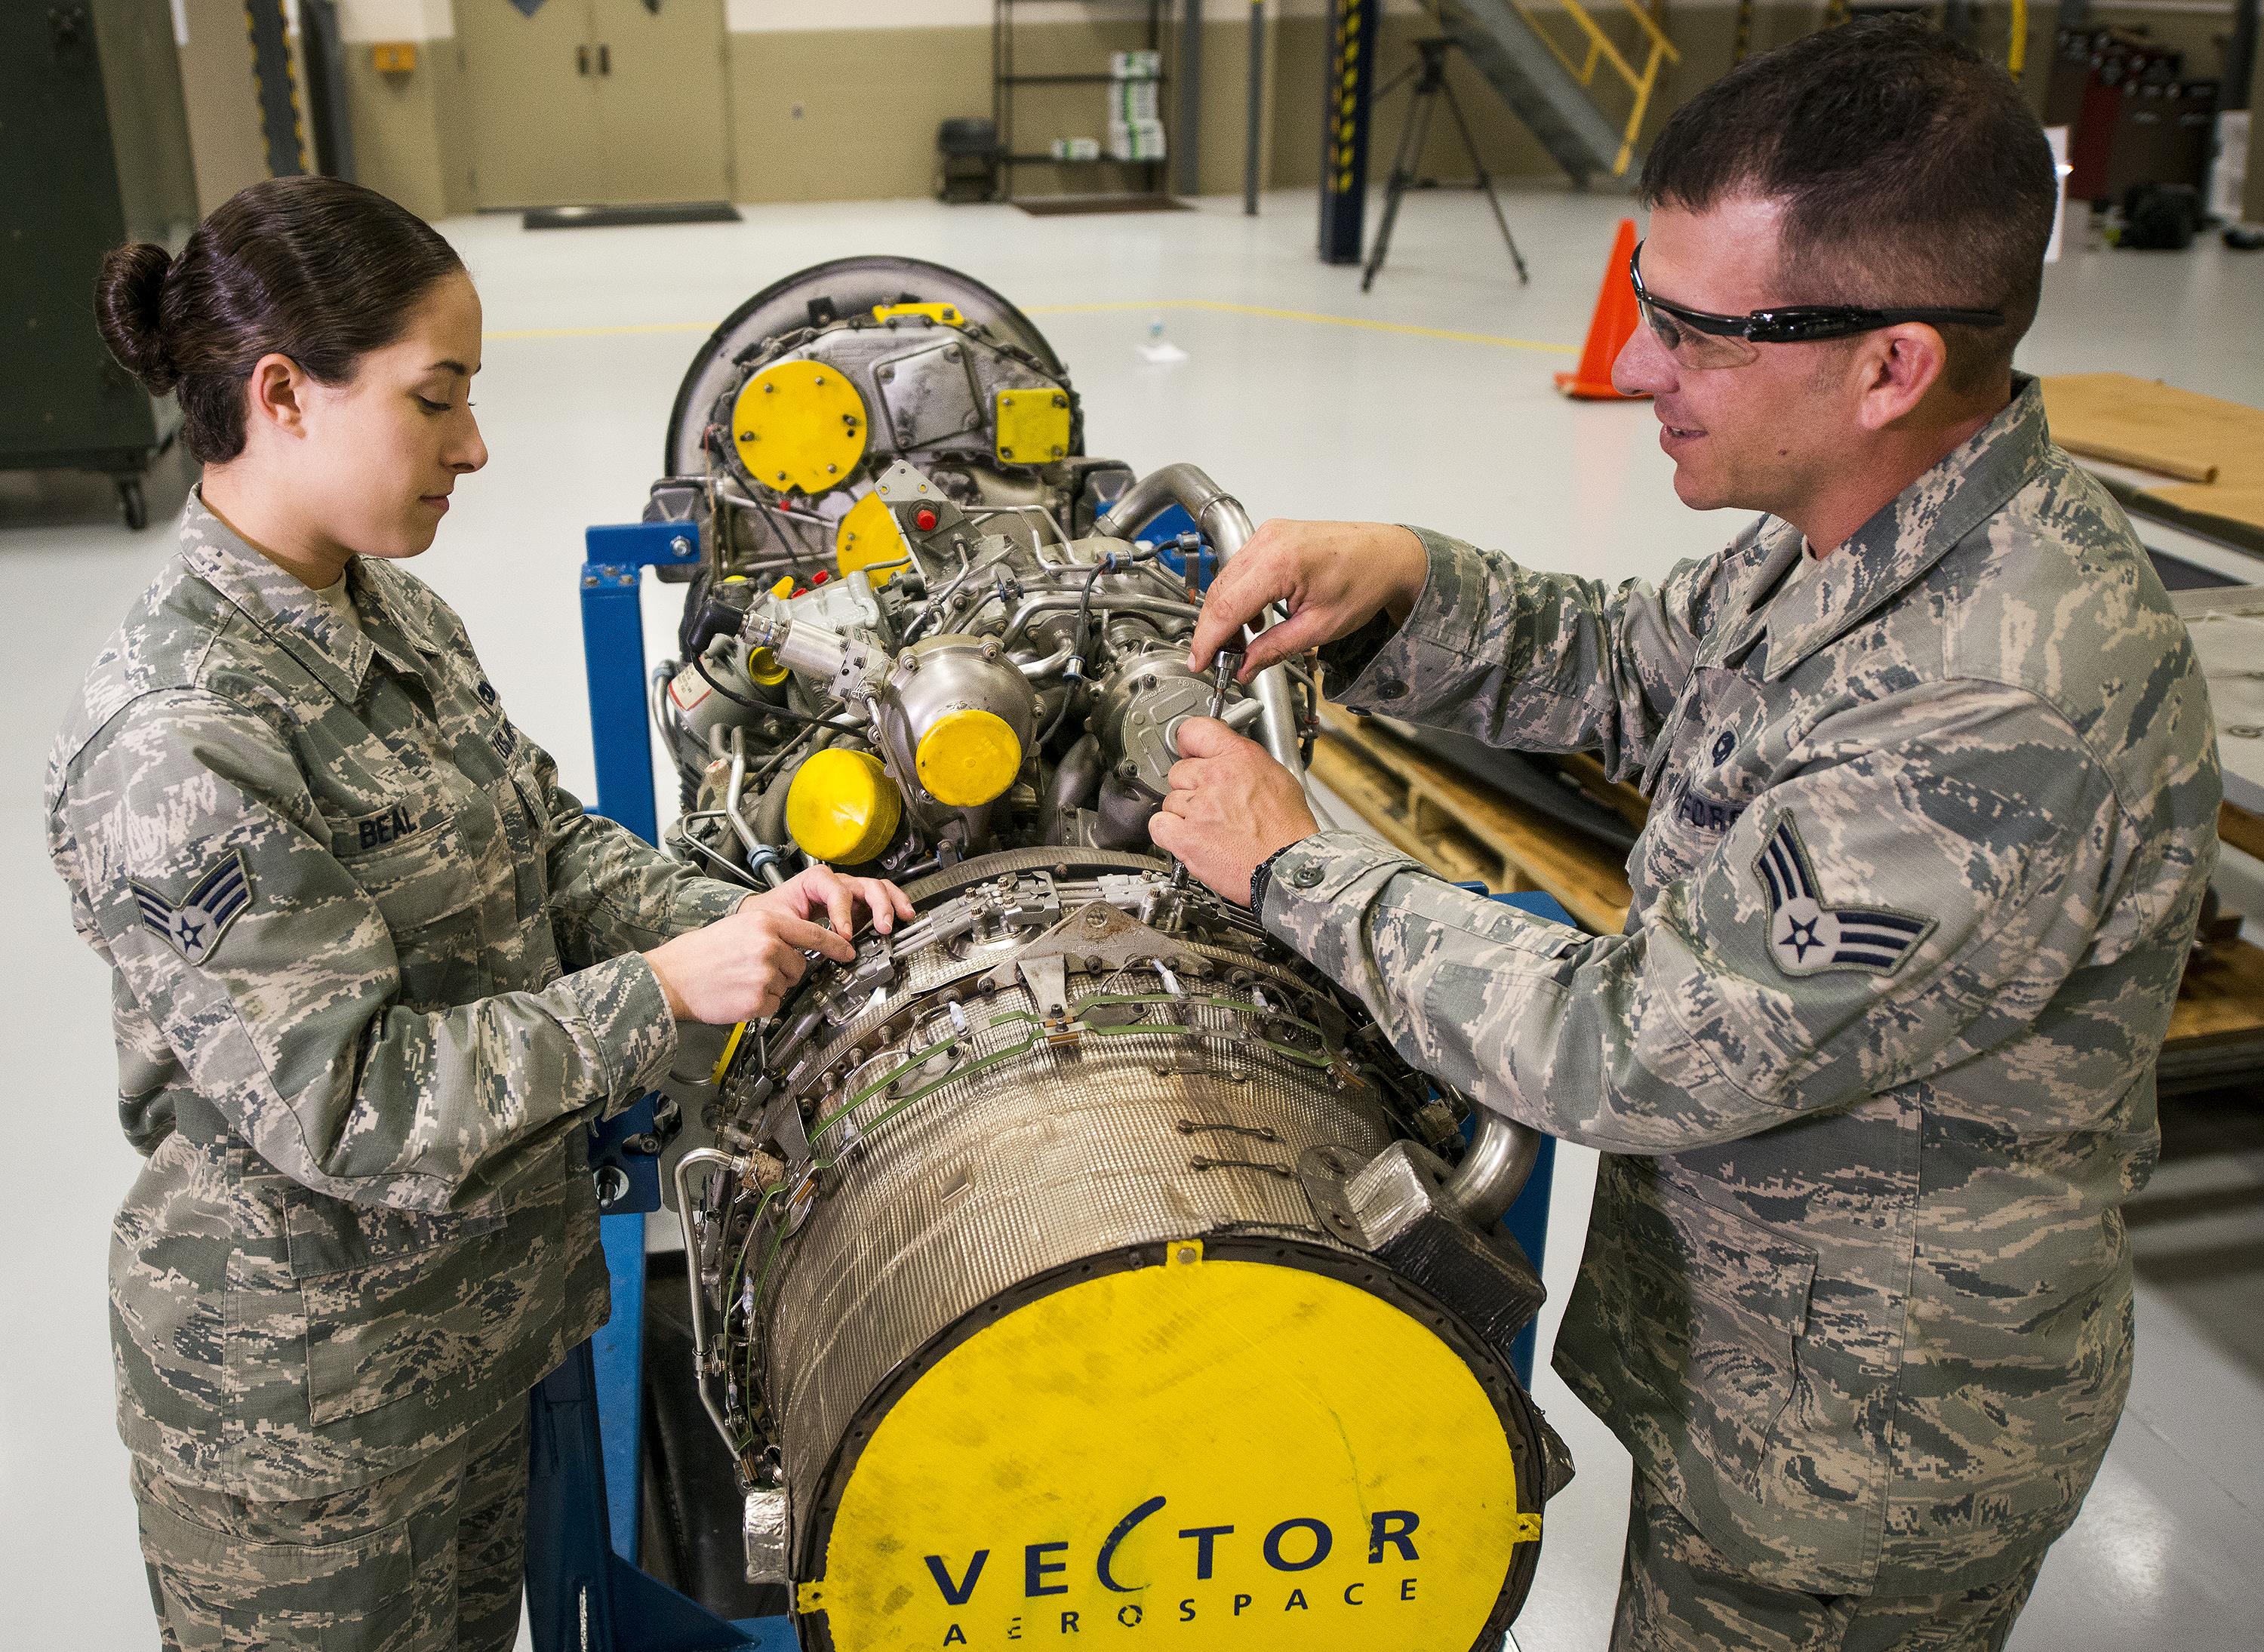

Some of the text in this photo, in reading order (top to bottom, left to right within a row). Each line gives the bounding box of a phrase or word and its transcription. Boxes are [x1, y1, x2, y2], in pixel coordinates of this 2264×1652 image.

[359, 806, 417, 848] BEAL
[924, 1496, 1420, 1605] VECTOR
[943, 1578, 1417, 1647] AEROSPACE
